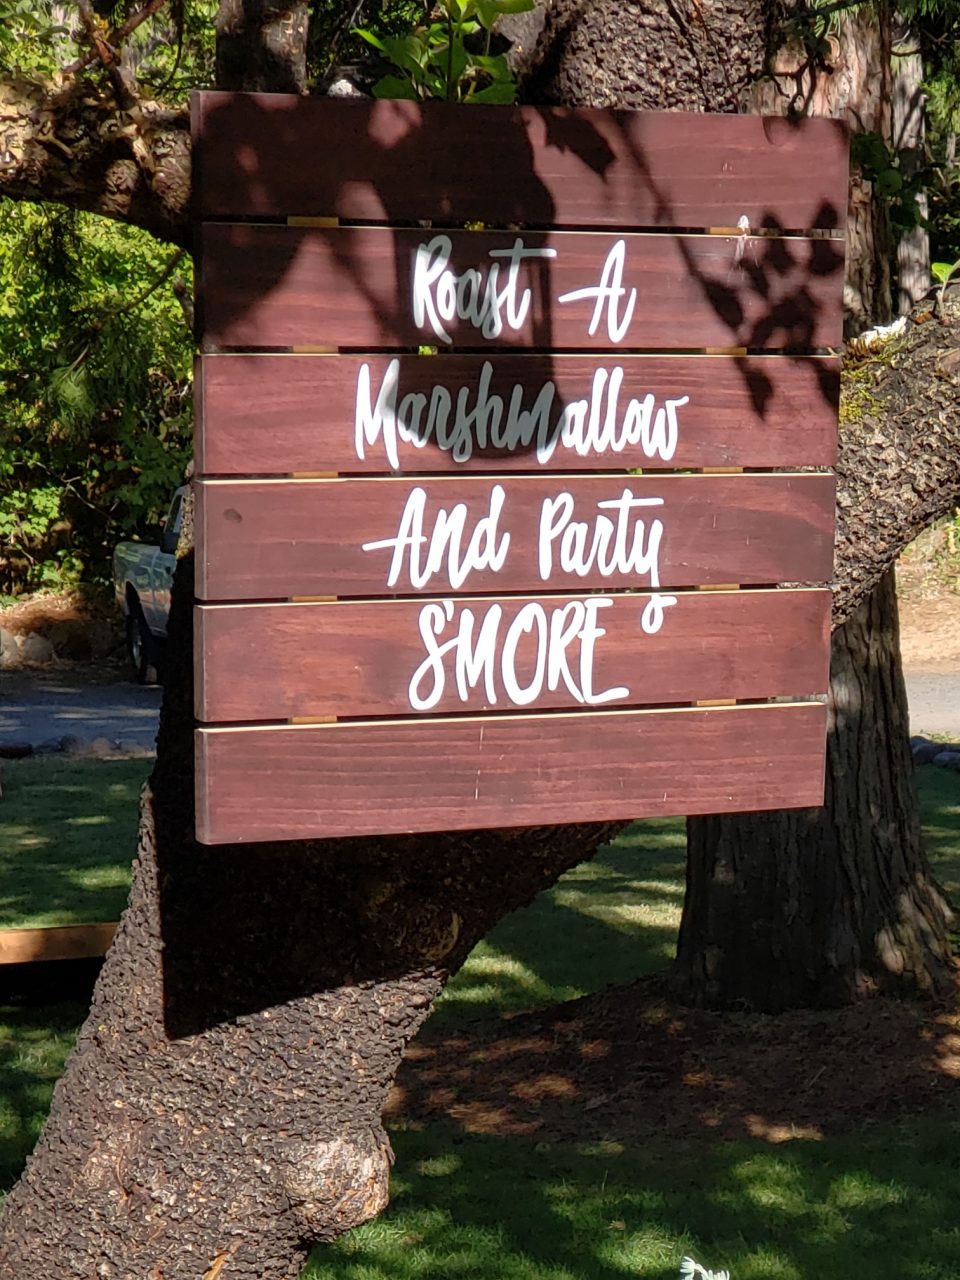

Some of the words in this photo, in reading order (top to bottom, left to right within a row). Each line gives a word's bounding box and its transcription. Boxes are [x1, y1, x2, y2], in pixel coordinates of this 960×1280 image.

[413, 234, 556, 343] Roast
[559, 240, 636, 343] A
[538, 489, 677, 633] Party
